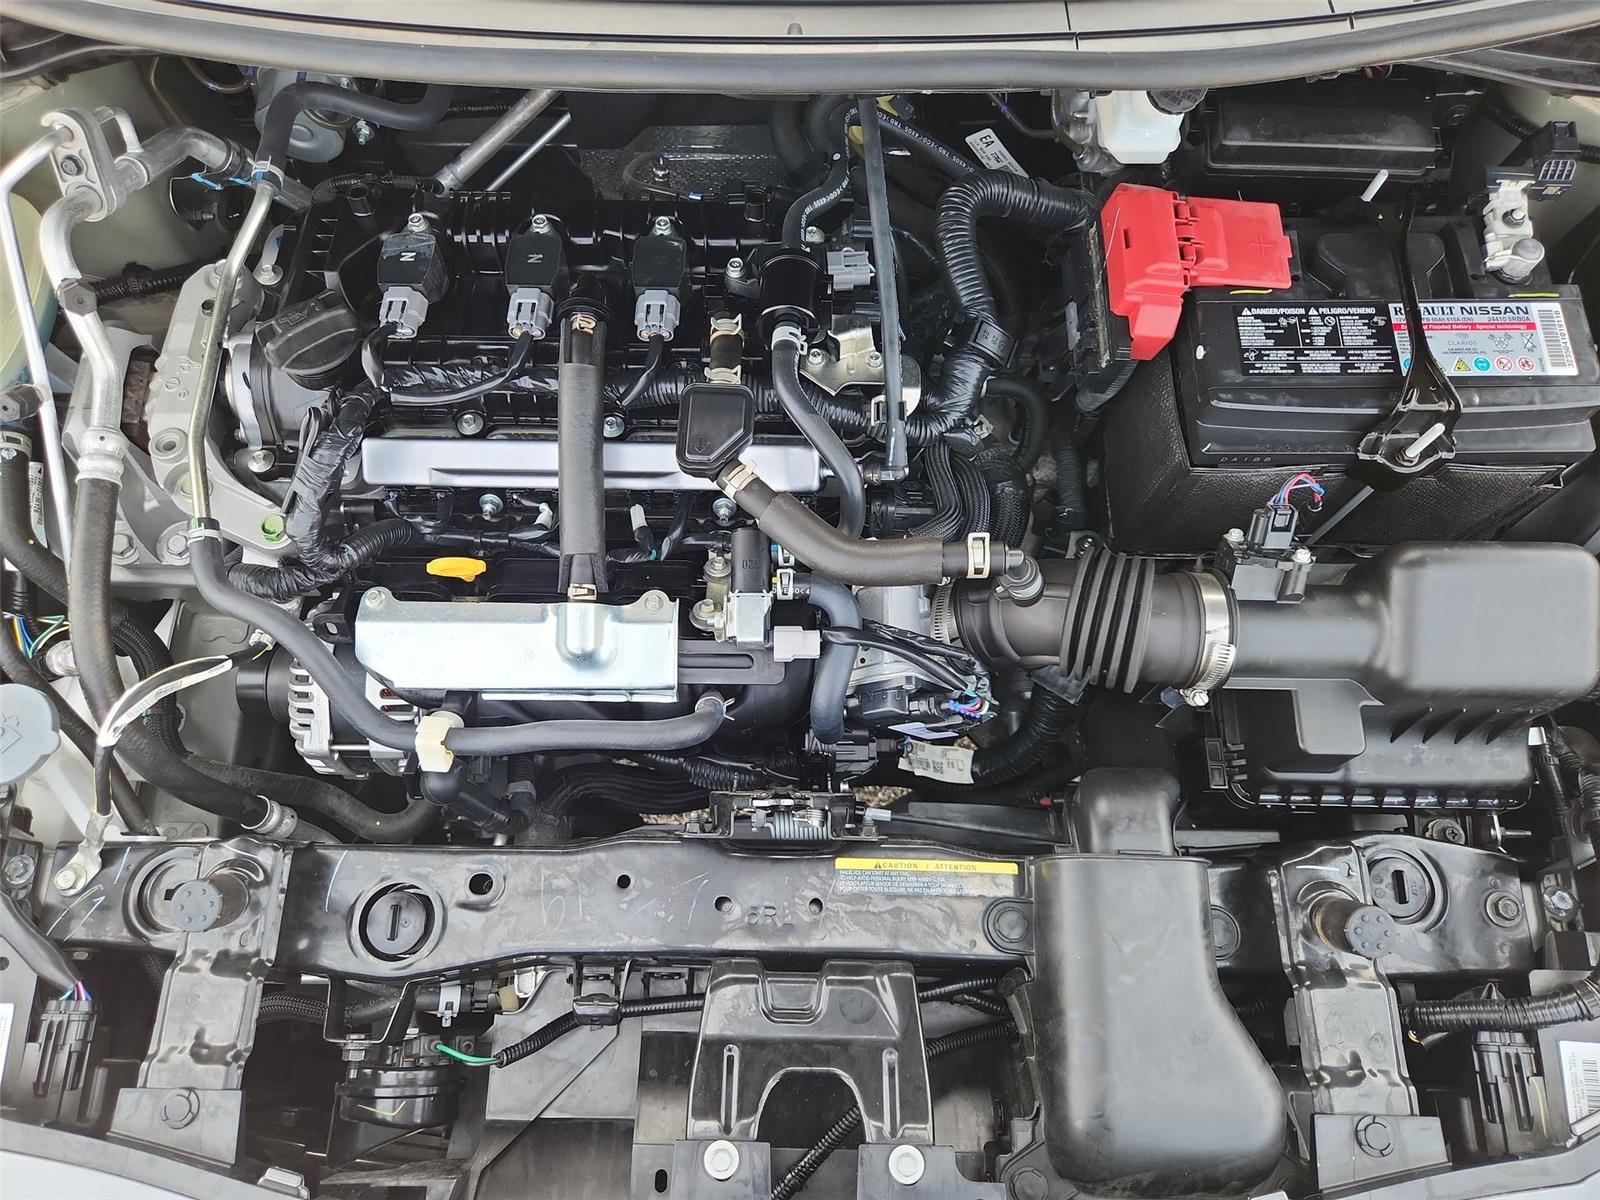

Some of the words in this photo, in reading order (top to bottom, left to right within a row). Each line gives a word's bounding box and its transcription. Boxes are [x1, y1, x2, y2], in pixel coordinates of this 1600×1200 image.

[980, 134, 995, 148] EA
[1319, 307, 1376, 315] PELIGRO/VENENO
[1393, 306, 1455, 316] RAULT
[1460, 306, 1530, 316] NISSAN
